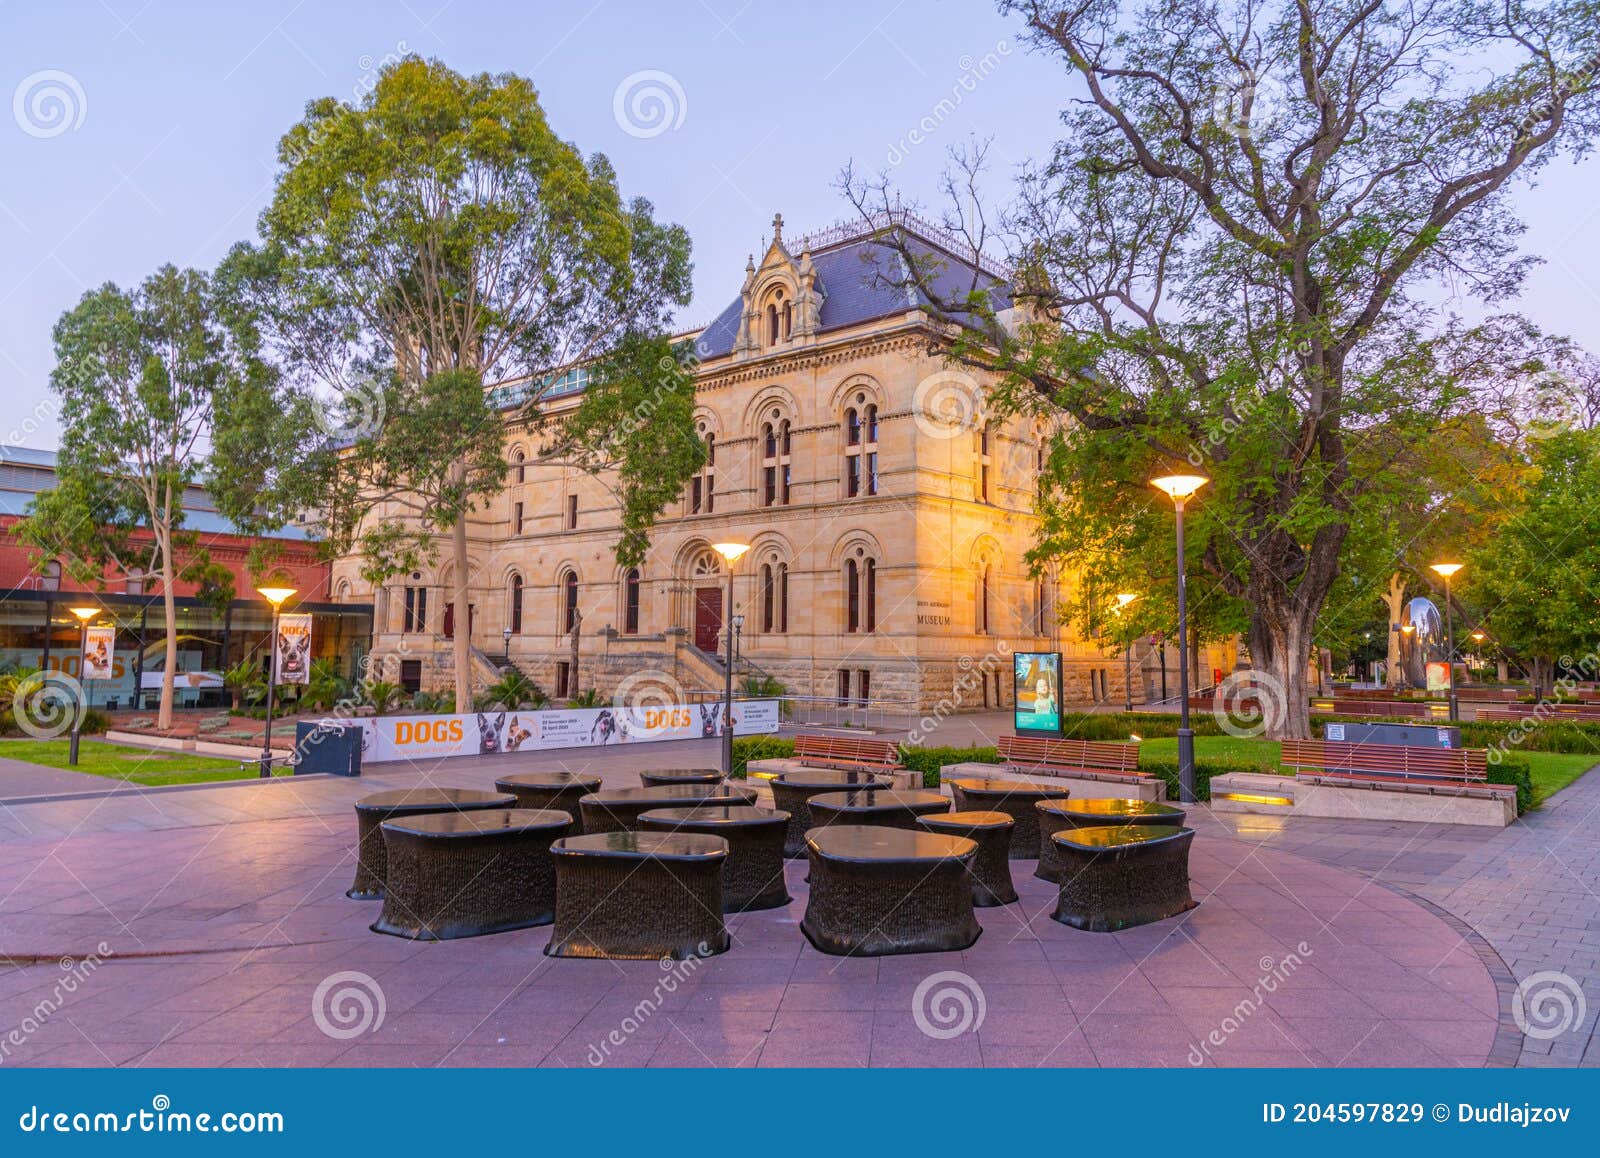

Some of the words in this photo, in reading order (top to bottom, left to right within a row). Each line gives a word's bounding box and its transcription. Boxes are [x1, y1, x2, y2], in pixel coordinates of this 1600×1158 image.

[917, 615, 951, 626] MUSEUM
[282, 626, 309, 636] DOGS
[37, 655, 125, 679] DOS
[645, 709, 691, 729] DOGS
[395, 719, 464, 745] DOGS
